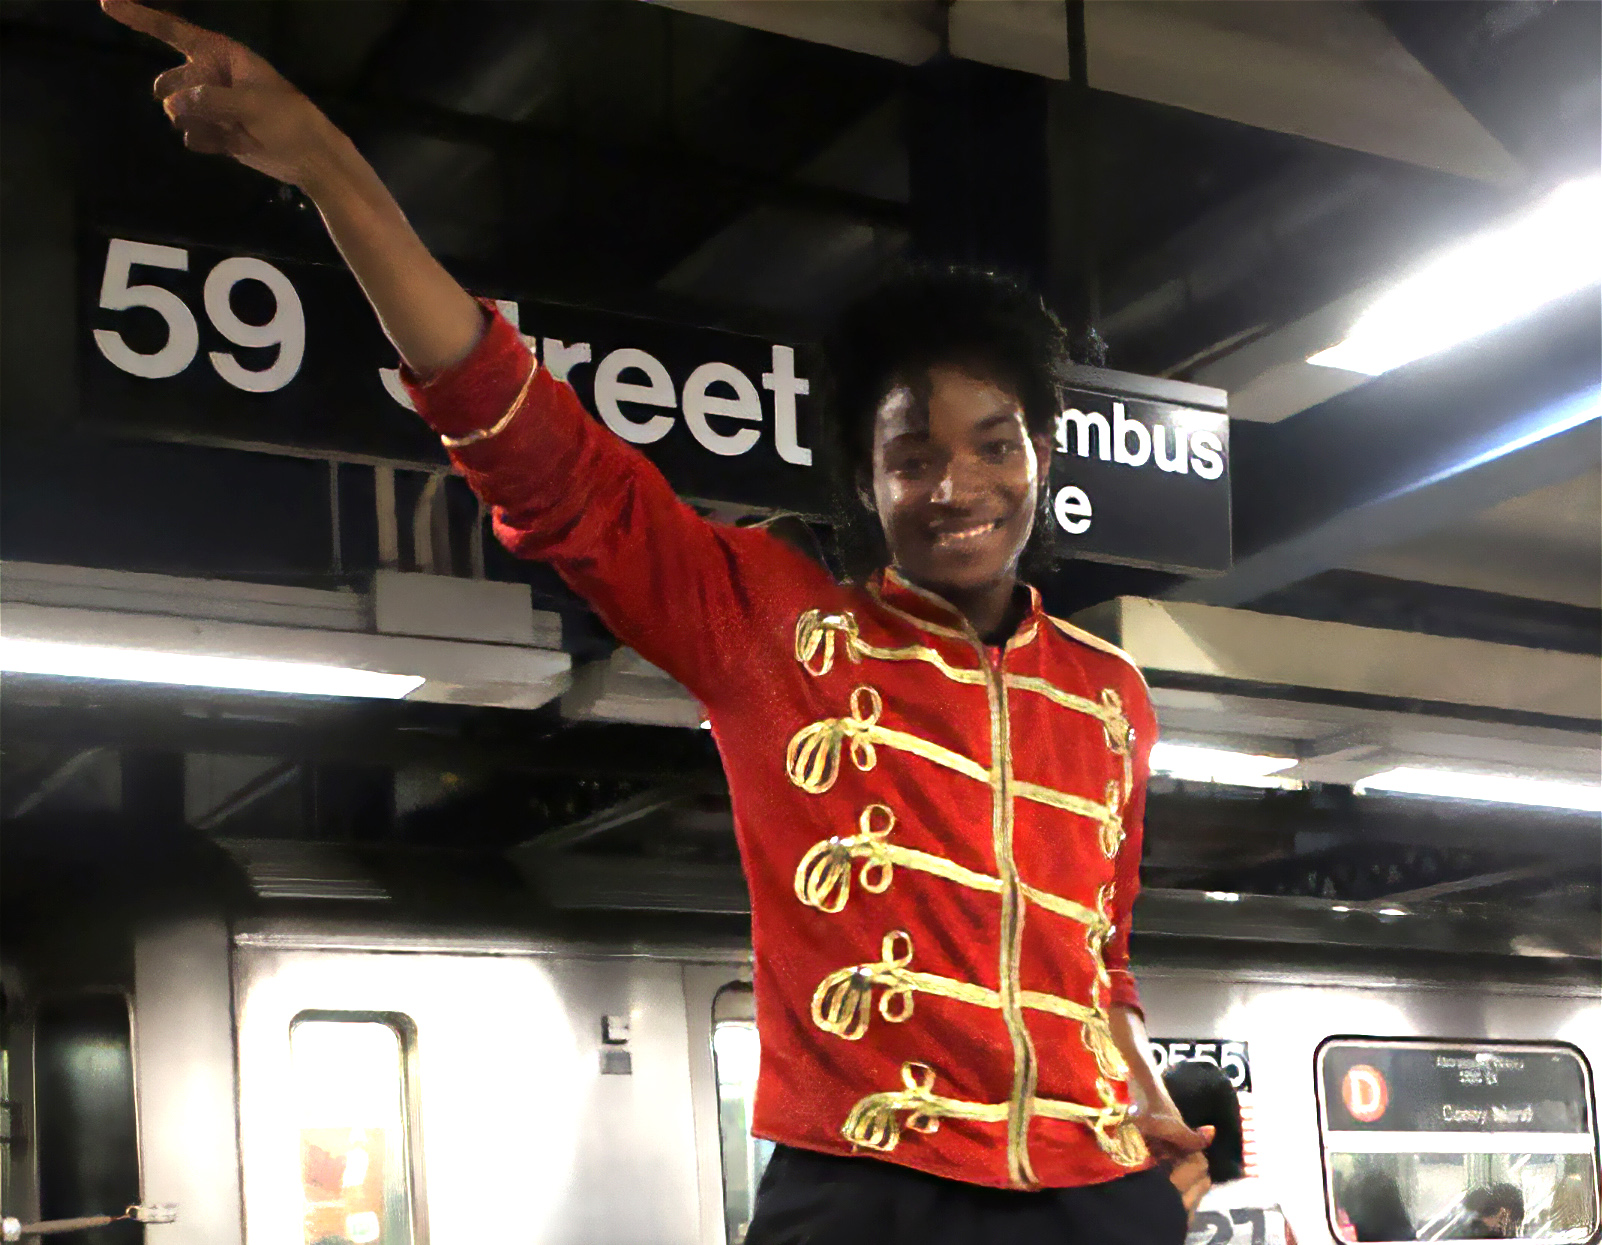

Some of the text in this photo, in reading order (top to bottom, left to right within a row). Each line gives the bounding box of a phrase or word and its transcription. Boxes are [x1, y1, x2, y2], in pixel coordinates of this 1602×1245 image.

[92, 238, 813, 467] 59 reet
[1349, 1069, 1382, 1114] D
